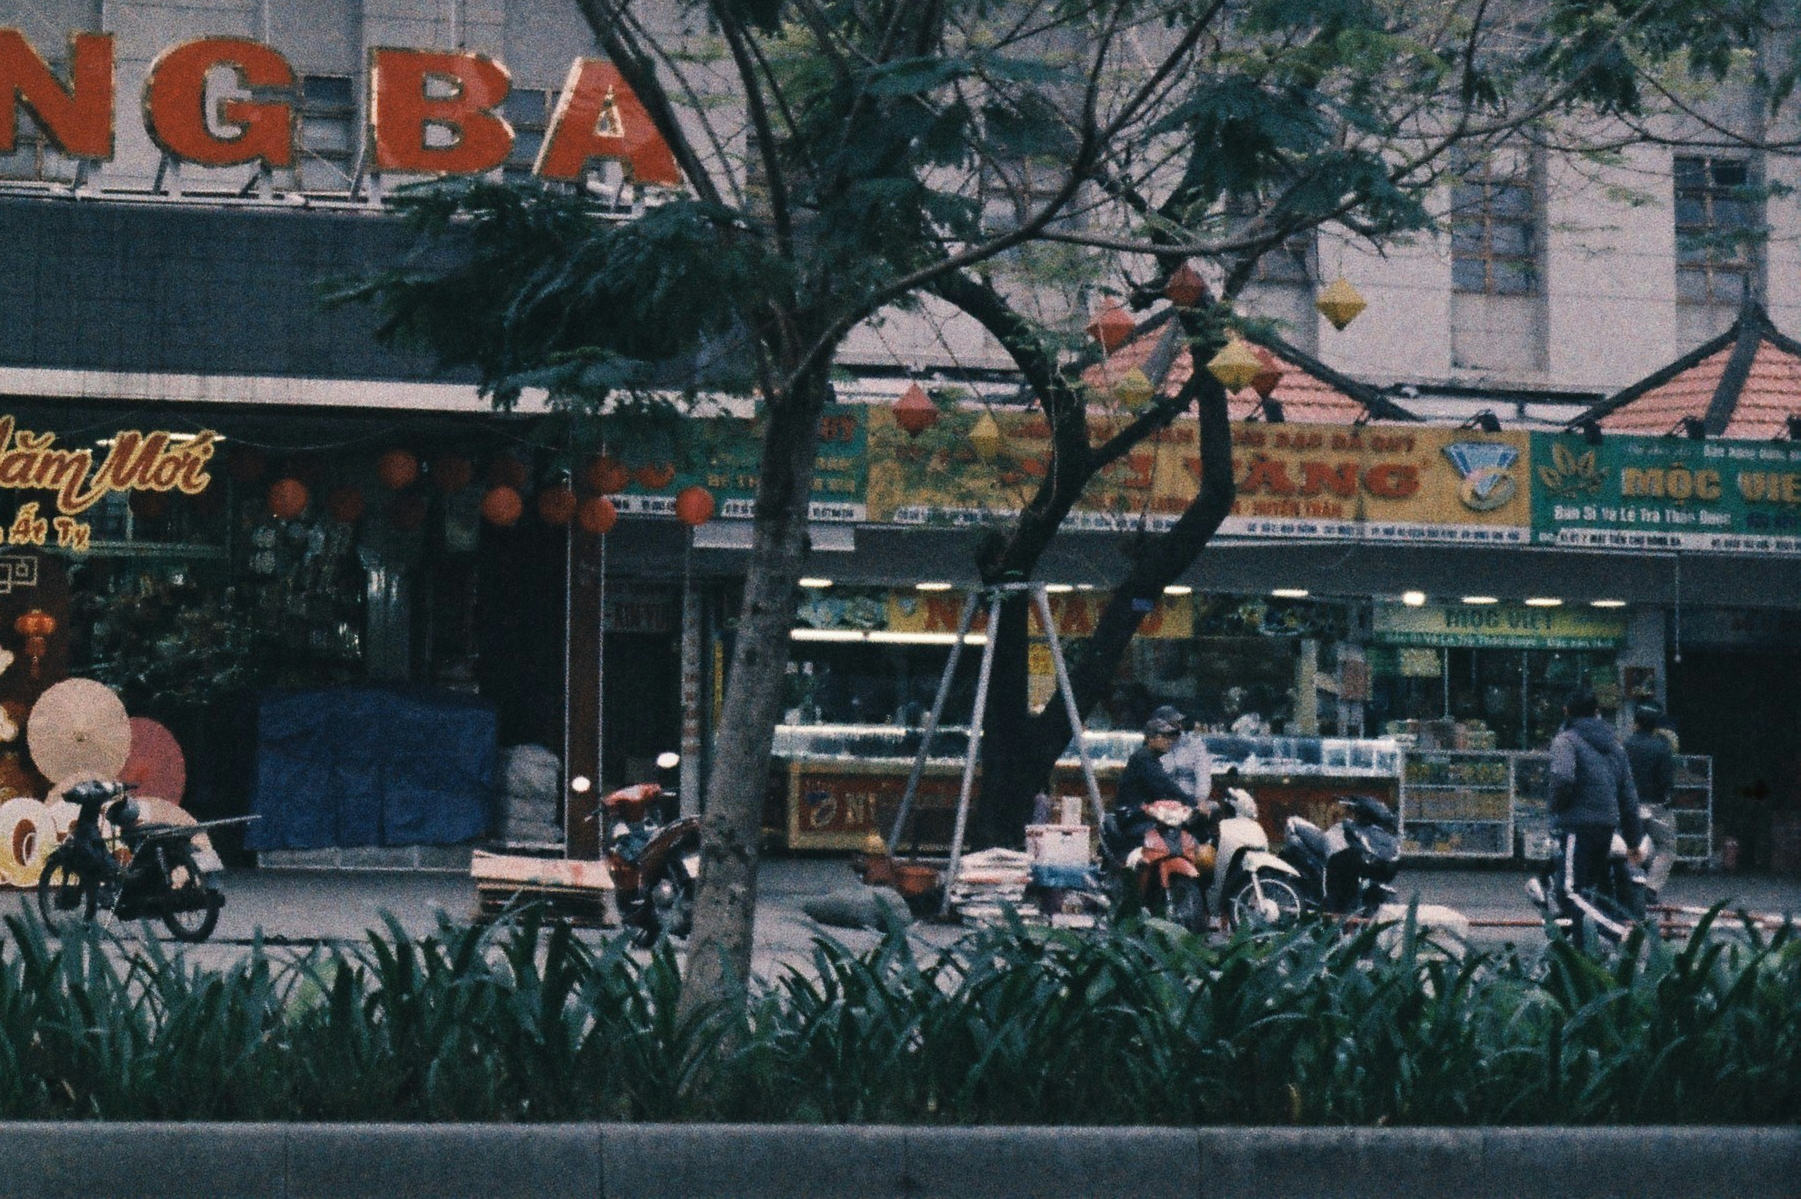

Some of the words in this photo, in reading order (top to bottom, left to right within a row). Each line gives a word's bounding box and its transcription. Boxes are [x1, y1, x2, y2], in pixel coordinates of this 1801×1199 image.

[370, 46, 685, 189] BA
[89, 428, 219, 495] Mới
[1620, 461, 1722, 506] MỘC
